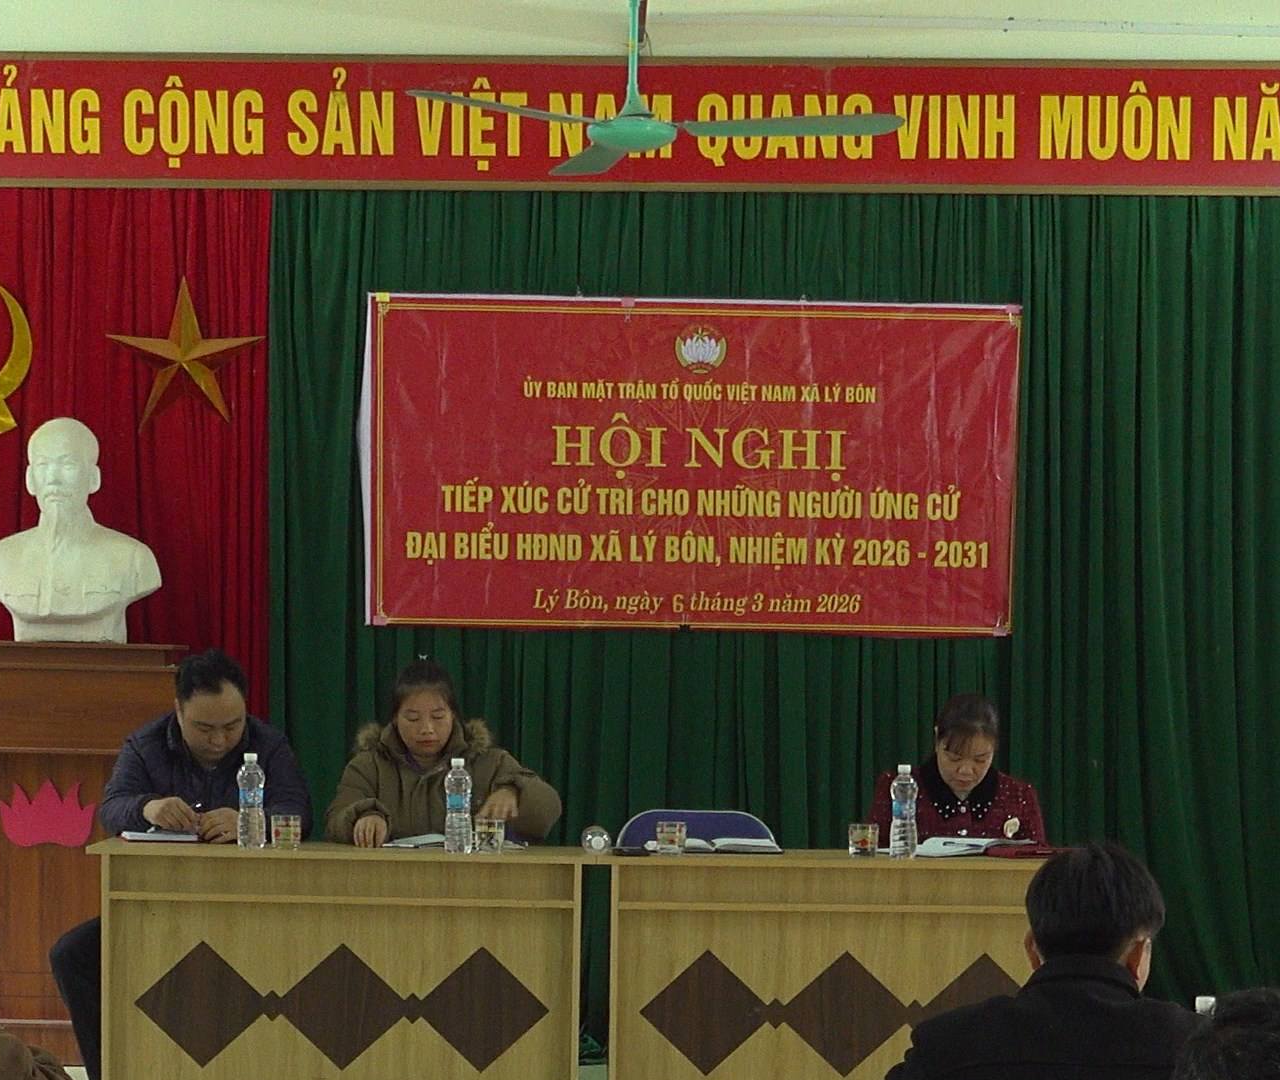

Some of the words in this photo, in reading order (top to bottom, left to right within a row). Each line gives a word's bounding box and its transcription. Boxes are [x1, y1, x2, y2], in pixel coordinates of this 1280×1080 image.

[124, 76, 263, 168] CỘNG
[287, 67, 395, 157] SẢN
[415, 77, 528, 171] VIỆT
[697, 93, 873, 167] QUANG
[893, 95, 1016, 160] VINH
[1040, 81, 1191, 160] MUÔN
[524, 376, 542, 397] ỦY
[547, 382, 577, 398] BAN
[582, 379, 614, 401] MẶT
[618, 380, 656, 403] TRẬN
[661, 378, 679, 400] TỔ
[683, 379, 722, 403] QUỐC
[727, 382, 757, 404] VIỆT
[762, 384, 796, 401] NAM
[801, 383, 820, 403] XÃ
[825, 383, 840, 402] LÝ
[846, 383, 876, 403] BÔN
[552, 413, 667, 480] HỘI
[685, 427, 846, 481] NGHỊ
[441, 477, 493, 512] TIẾP
[501, 481, 548, 513] XÚC
[557, 479, 591, 514] CỬ
[596, 486, 633, 515] TRI
[642, 488, 689, 516] CHO
[697, 485, 781, 517] NHỮNG
[789, 485, 861, 519] NGƯỜI
[870, 486, 918, 520] ỨNG
[927, 485, 961, 520] CỬ
[406, 532, 446, 565] ĐẠI
[455, 522, 508, 560] BIỂU
[517, 534, 582, 561] HĐND
[590, 530, 622, 561] XÃ
[630, 530, 656, 562] LÝ
[665, 530, 720, 566] BÔN,
[730, 532, 807, 570] NHIỆM
[816, 533, 845, 565] KỲ
[853, 538, 910, 566] 2026
[934, 540, 987, 568] 2031
[534, 589, 559, 612] Lý
[565, 589, 608, 612] Bôn,
[616, 592, 662, 614] ngày
[673, 594, 683, 612] 6
[690, 592, 747, 615] tháng
[752, 593, 763, 611] 3
[769, 594, 810, 612] năm
[816, 594, 860, 613] 2026
